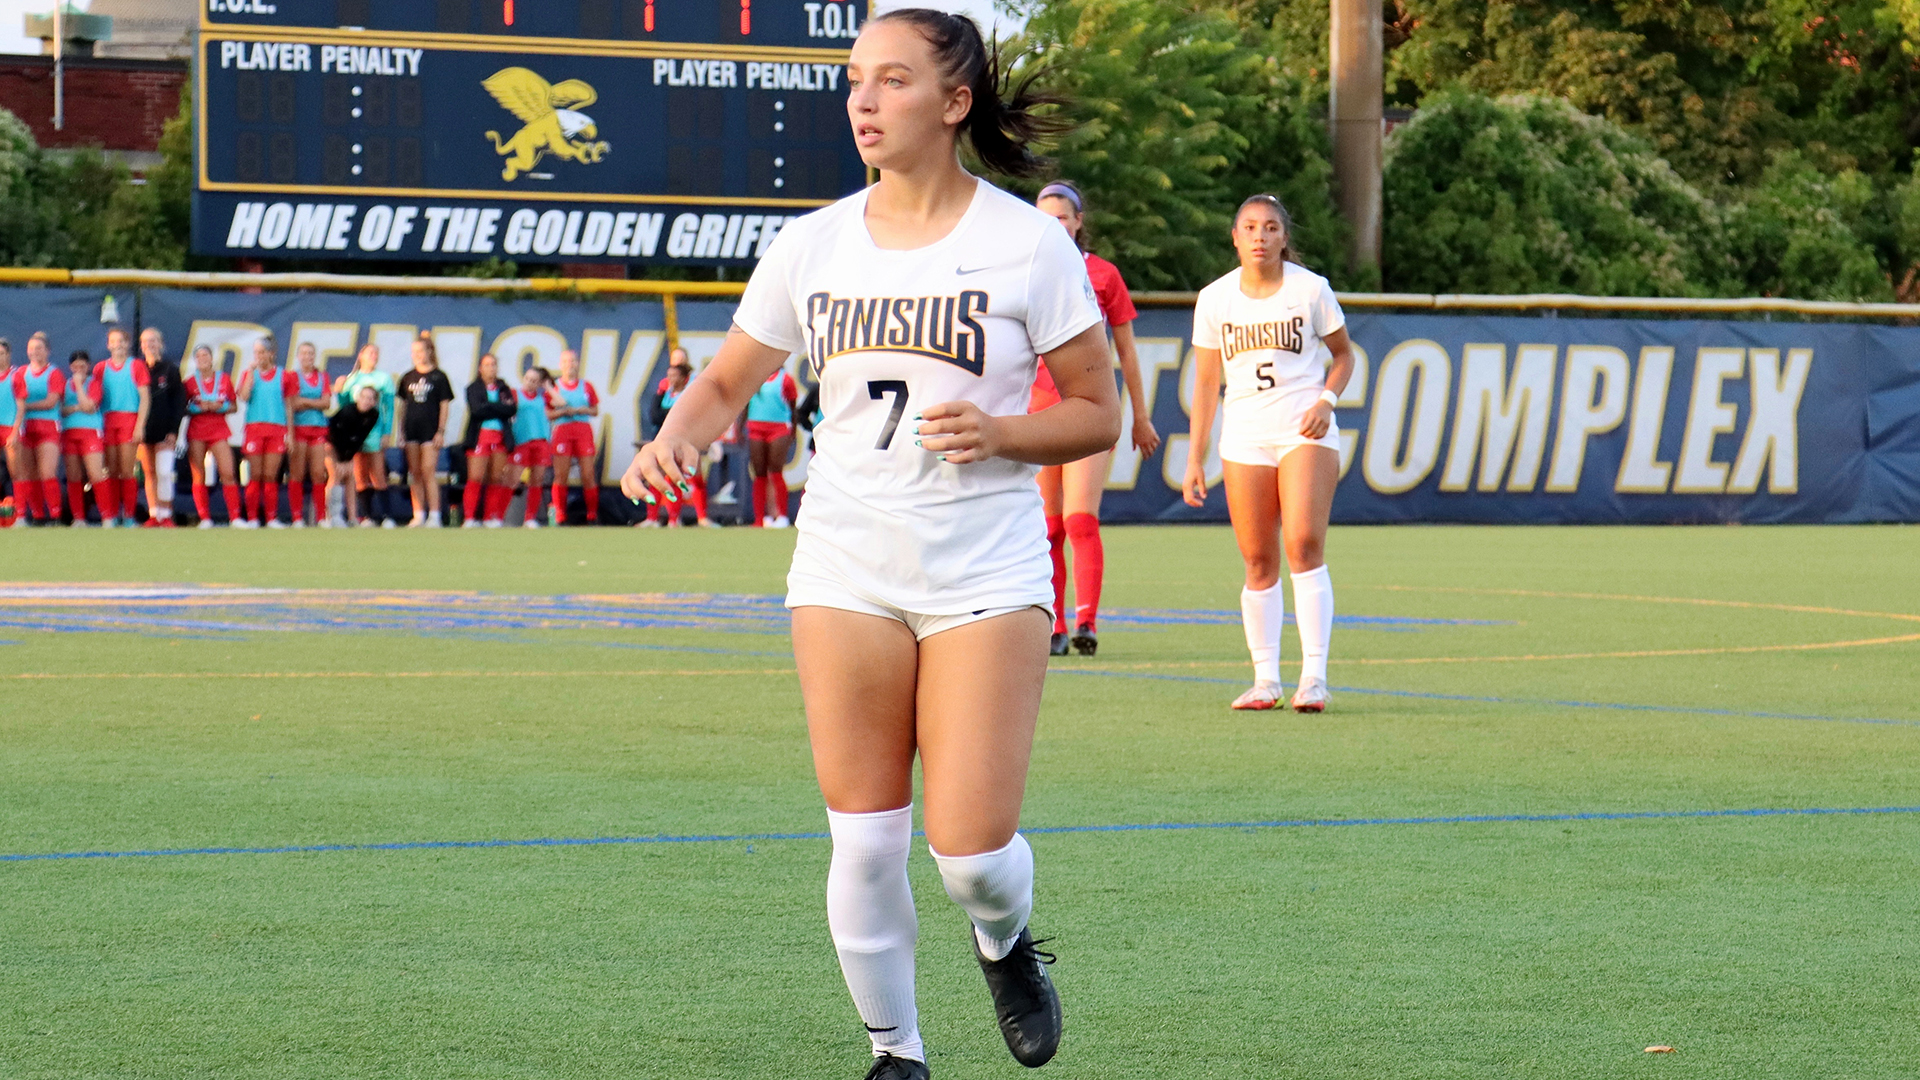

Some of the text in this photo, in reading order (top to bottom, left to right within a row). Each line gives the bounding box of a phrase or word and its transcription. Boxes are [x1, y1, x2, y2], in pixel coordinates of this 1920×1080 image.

[221, 41, 423, 76] PLAYER PENALTY
[653, 58, 841, 91] PLAYER PENALTY
[226, 202, 797, 259] HOME OF THE GOLDEN GRIFF
[807, 290, 989, 381] CANISIUS
[1222, 316, 1304, 361] CANISIUS
[1256, 362, 1275, 391] 5
[867, 380, 909, 450] 7
